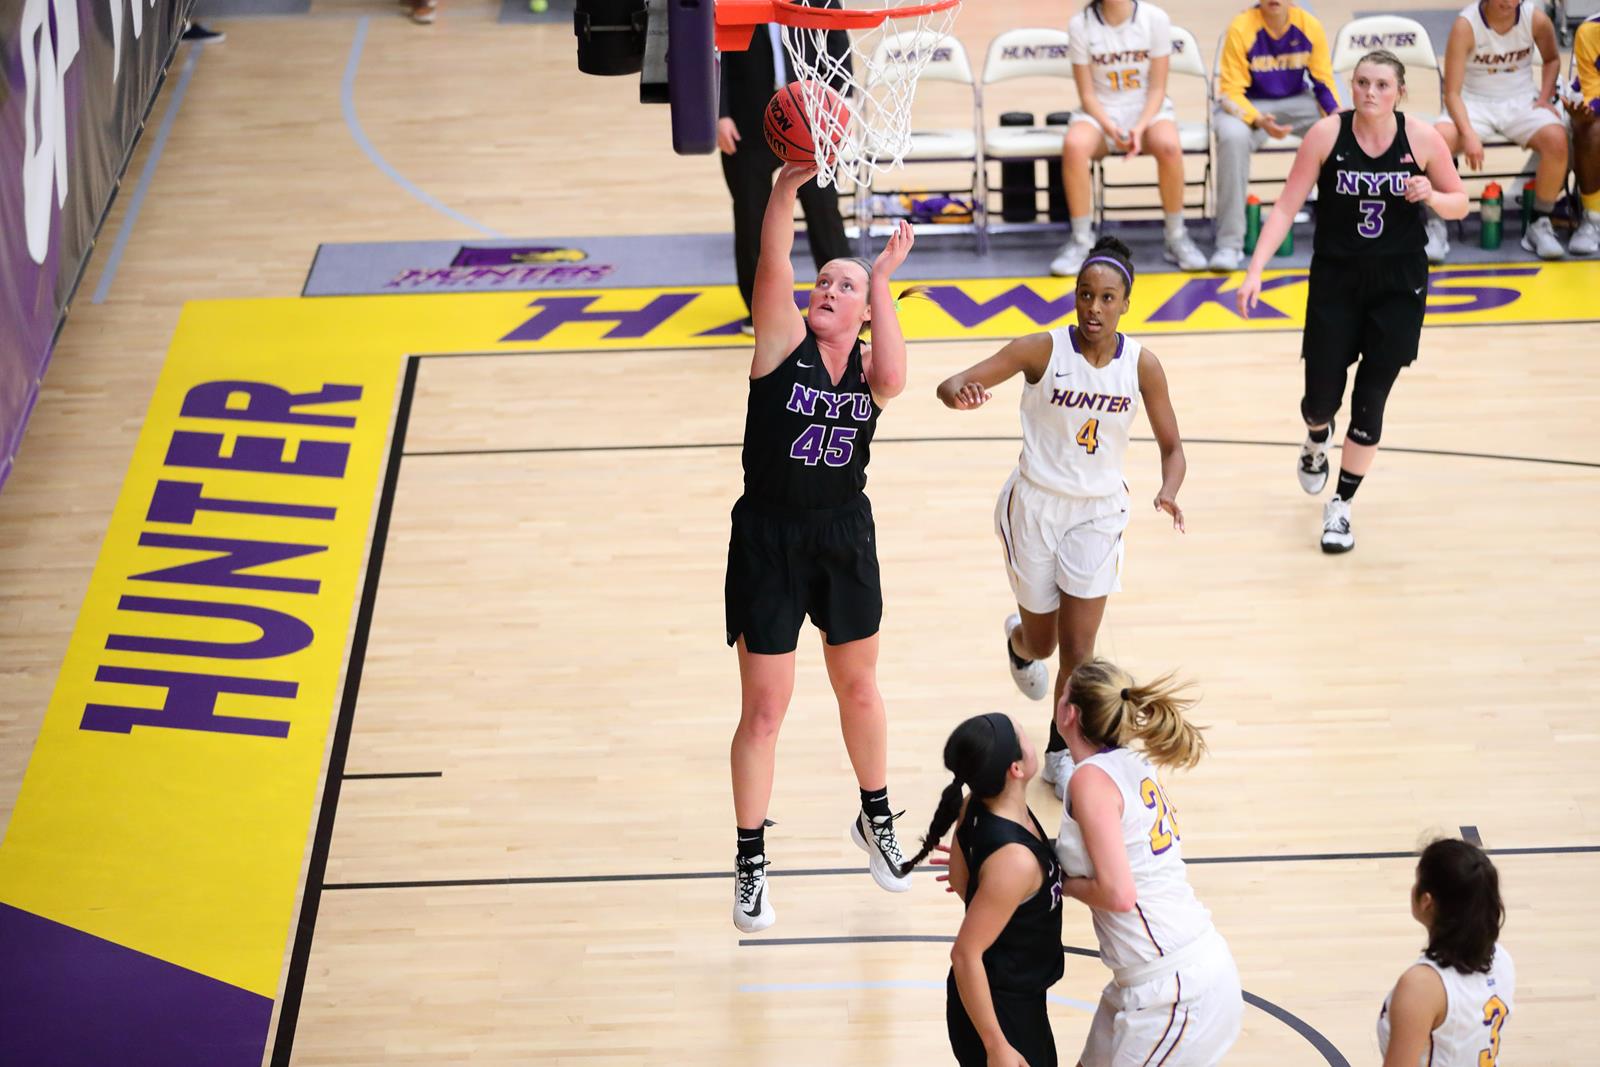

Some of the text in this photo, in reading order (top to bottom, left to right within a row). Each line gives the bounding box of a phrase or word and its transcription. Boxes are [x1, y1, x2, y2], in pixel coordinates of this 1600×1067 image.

[1336, 169, 1411, 196] NYU
[1357, 200, 1386, 238] 3
[500, 268, 1541, 342] HWKS
[786, 382, 873, 421] NYU
[1051, 388, 1131, 414] HUNTER
[790, 424, 858, 467] 45
[1076, 418, 1100, 455] 4
[79, 380, 363, 738] HUNTER
